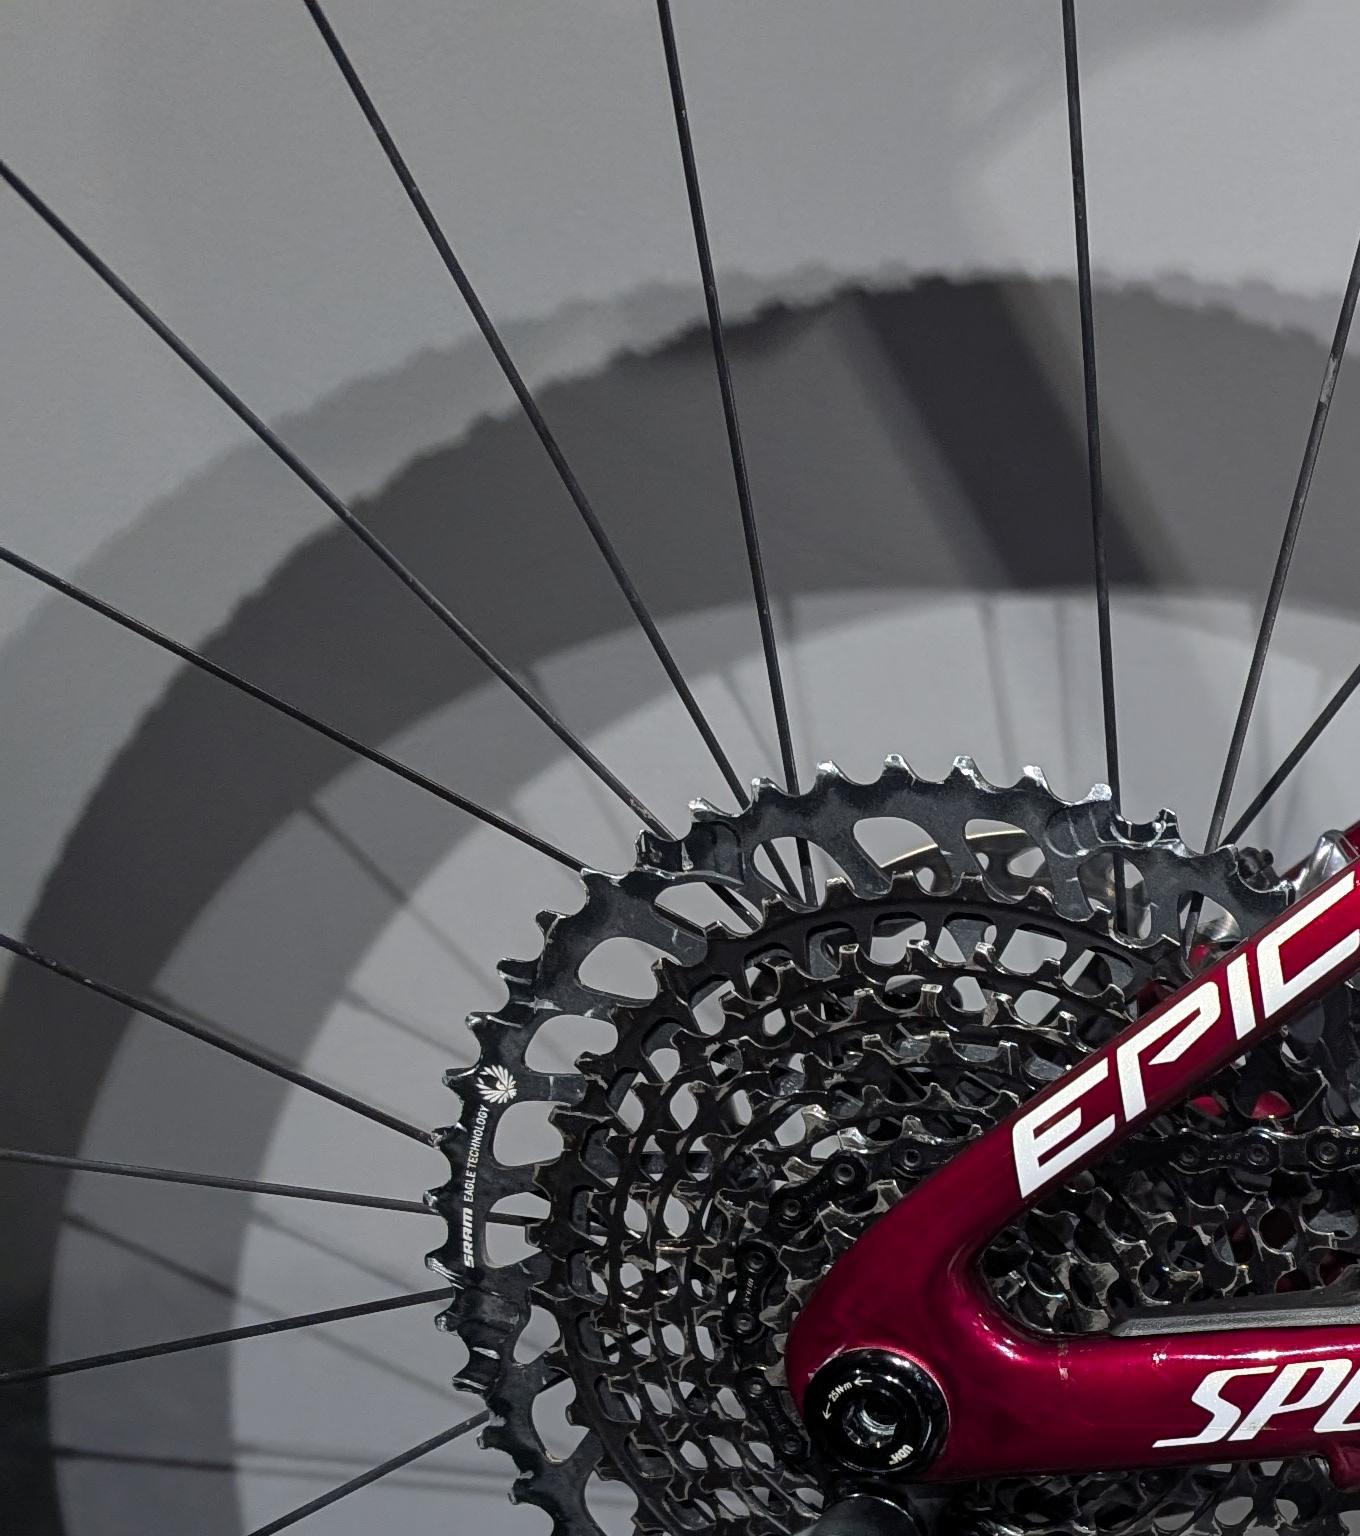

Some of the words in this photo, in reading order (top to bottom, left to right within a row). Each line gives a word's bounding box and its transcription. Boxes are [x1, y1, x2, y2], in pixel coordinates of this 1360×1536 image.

[1012, 870, 1360, 1198] EPIC
[466, 1103, 491, 1170] TECHNOLOGY
[463, 1169, 477, 1203] EAGLE
[463, 1207, 475, 1269] SRAM
